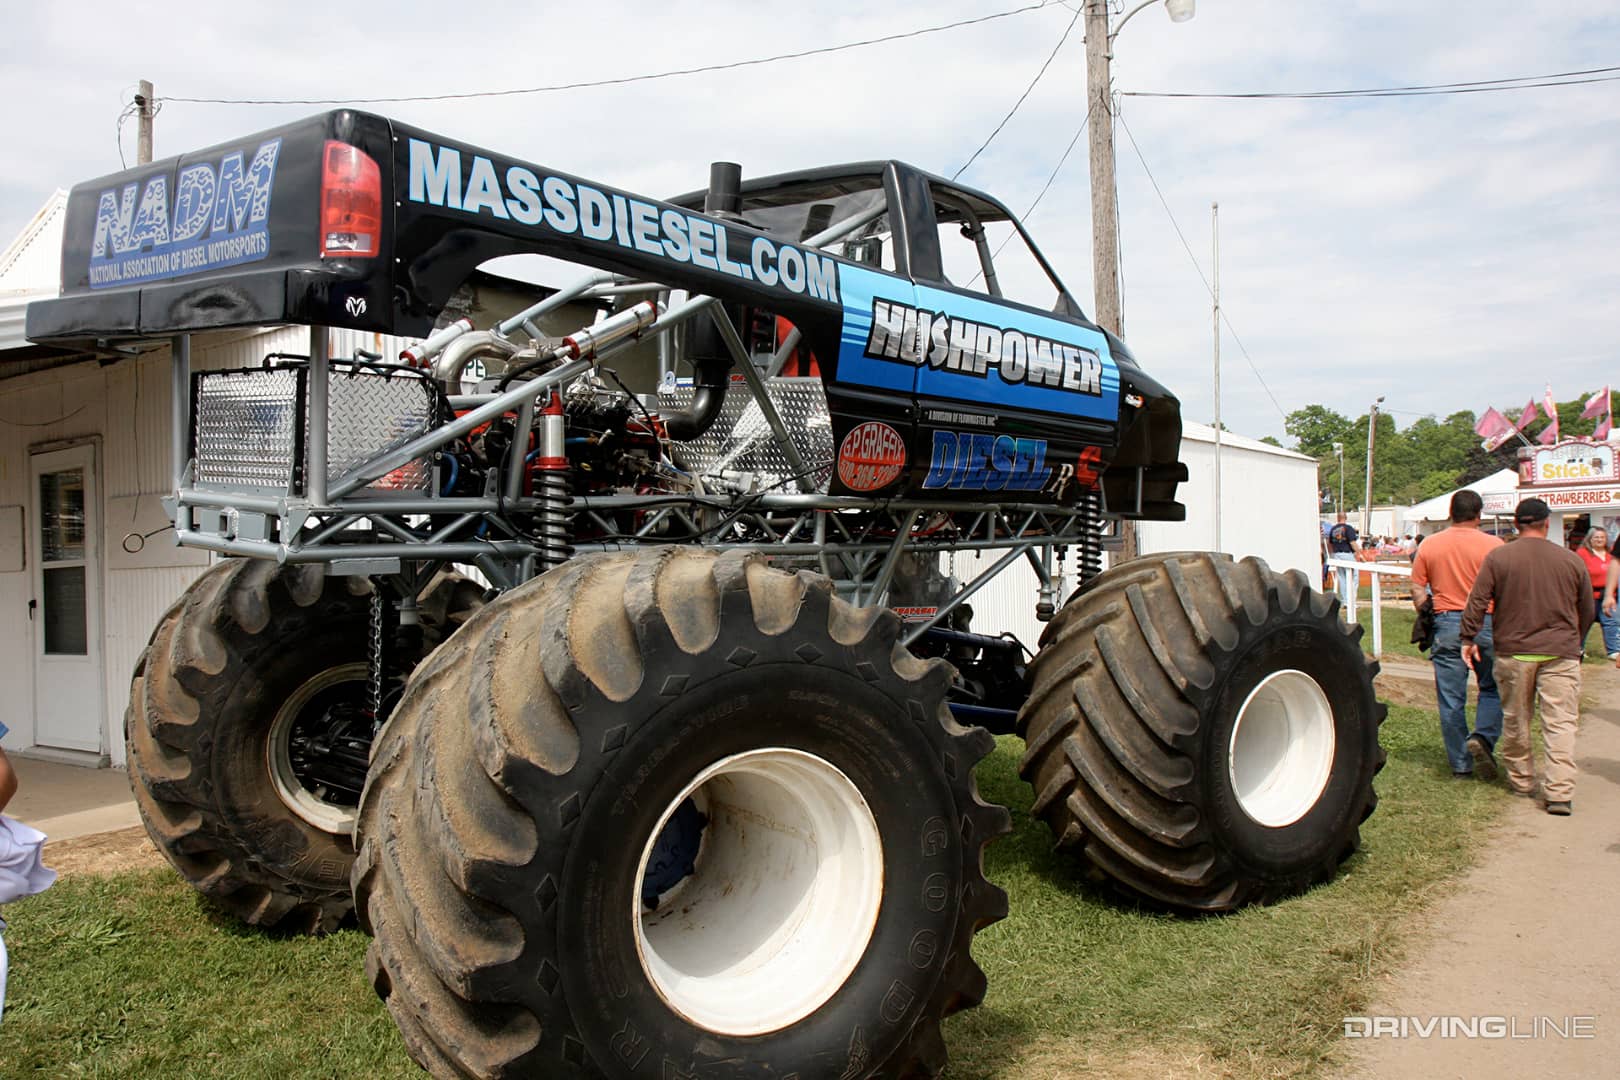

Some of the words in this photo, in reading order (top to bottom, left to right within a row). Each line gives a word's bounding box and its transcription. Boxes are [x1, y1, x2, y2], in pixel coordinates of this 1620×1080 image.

[92, 137, 282, 258] NADM
[409, 137, 838, 303] MASSDIESEL.COM
[90, 264, 122, 284] NATIONAL
[123, 256, 170, 278] ASSOCIATION
[170, 251, 180, 271] OF
[182, 246, 208, 269] DIESEL
[208, 231, 267, 264] MOTORSPORTS
[865, 298, 1103, 396] HUSHPOWER
[922, 430, 1053, 491] DIESEL
[1542, 463, 1591, 479] Stick
